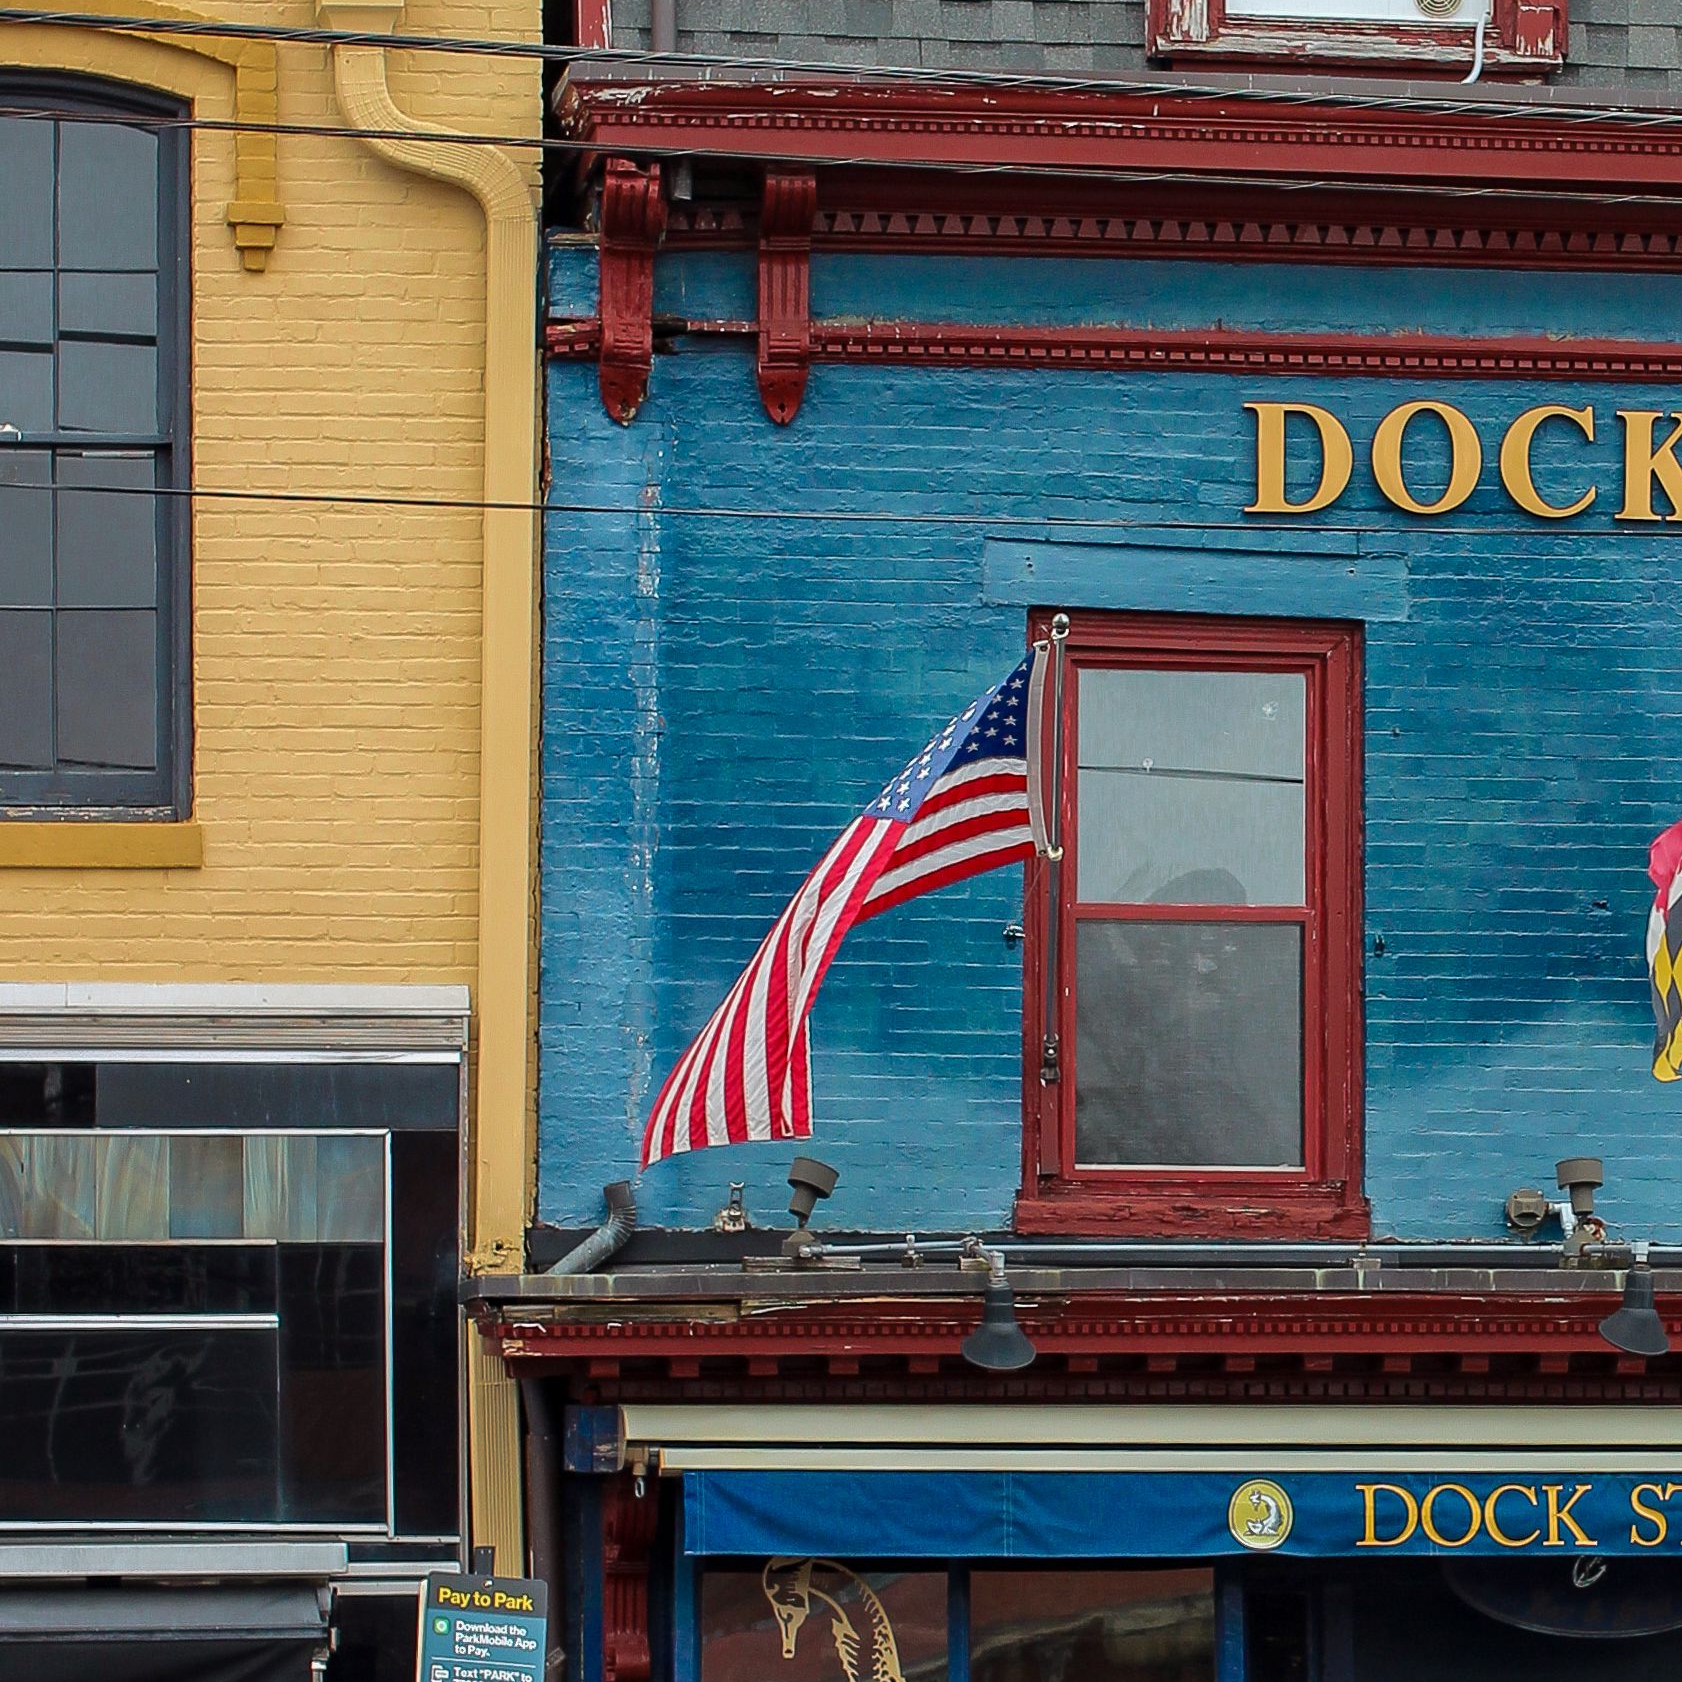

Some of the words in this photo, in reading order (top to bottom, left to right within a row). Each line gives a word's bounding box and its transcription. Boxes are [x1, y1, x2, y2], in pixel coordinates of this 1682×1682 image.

[1355, 1482, 1599, 1548] DOCK
[438, 1587, 471, 1607] Pay
[473, 1593, 491, 1606] to
[494, 1592, 534, 1611] Park
[455, 1620, 508, 1634] Download
[509, 1625, 527, 1636] the
[455, 1632, 513, 1647] ParkMobile
[514, 1638, 537, 1650] App
[455, 1645, 466, 1654] to
[467, 1645, 491, 1657] Pay.
[454, 1667, 478, 1679] Text
[480, 1669, 519, 1682] "PARK"
[521, 1674, 533, 1682] to
